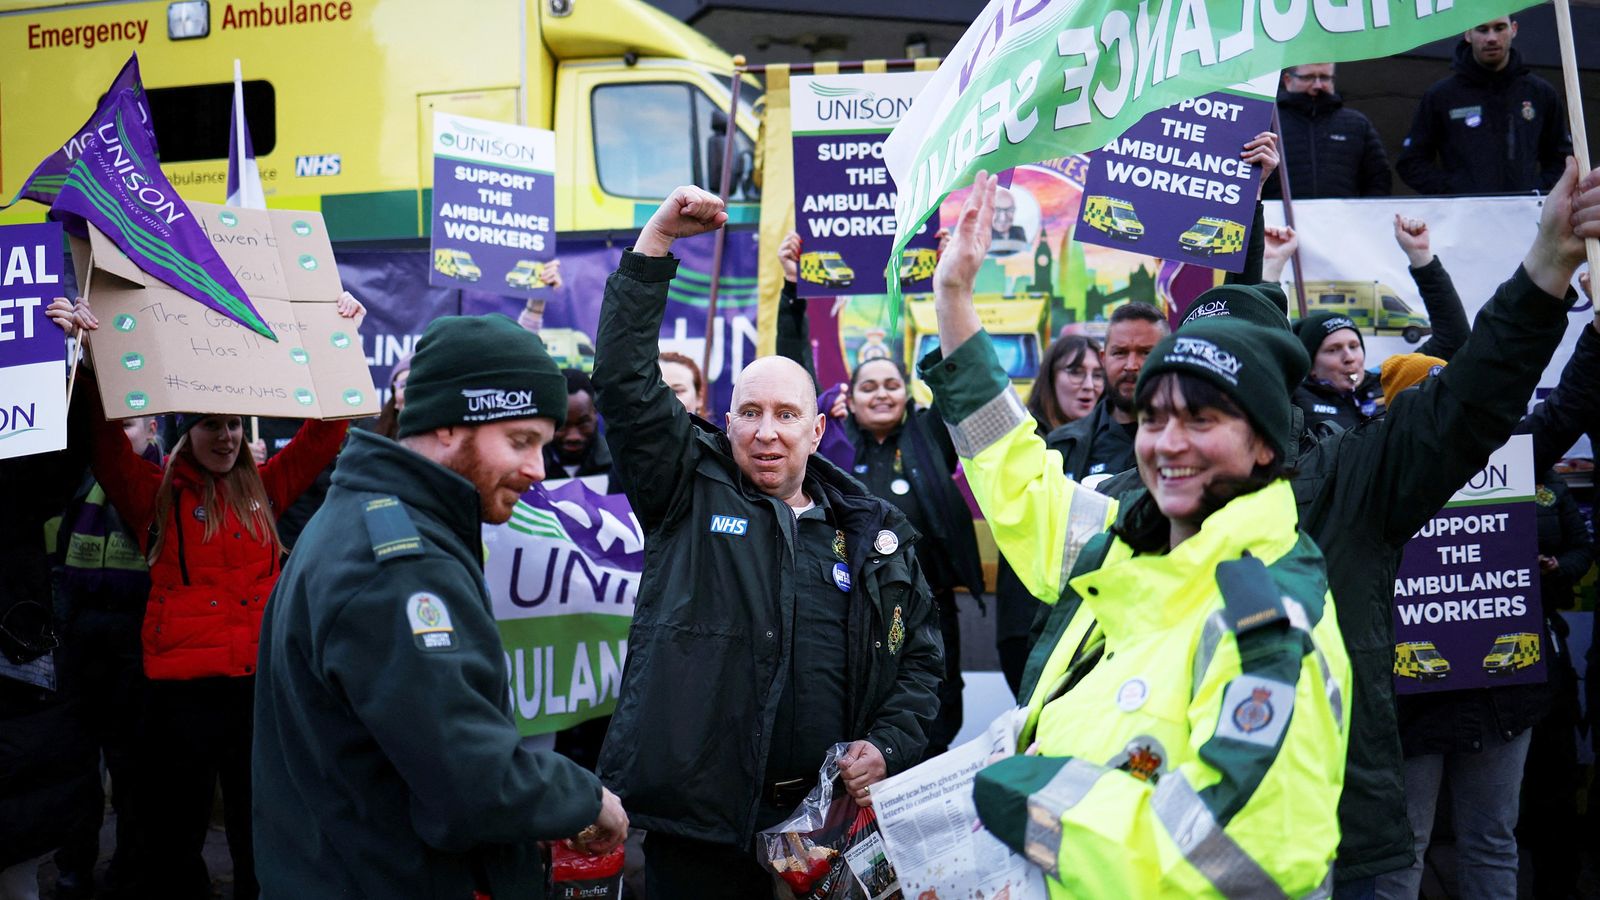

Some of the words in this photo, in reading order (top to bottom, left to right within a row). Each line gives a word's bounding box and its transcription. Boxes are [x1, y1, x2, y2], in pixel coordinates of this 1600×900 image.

[28, 20, 148, 50] Emergency
[222, 0, 353, 31] Ambulance
[817, 97, 913, 121] UNISON
[1166, 97, 1244, 122] PORT
[1161, 117, 1208, 143] THE
[455, 134, 535, 161] UNISON
[817, 141, 886, 161] SUPPO
[1103, 137, 1253, 181] AMBULANCE
[98, 122, 185, 224] UNISON
[296, 156, 341, 177] NHS
[454, 165, 536, 192] SUPPORT
[846, 167, 888, 186] THE
[1105, 160, 1242, 205] WORKERS
[477, 187, 513, 207] THE
[802, 192, 900, 213] AMBULAN
[439, 202, 550, 233] AMBULANCE
[808, 215, 927, 238] WORKE
[443, 220, 546, 252] WORKERS
[0, 244, 59, 287] AL
[139, 302, 190, 326] The
[1173, 339, 1243, 374] UNISON
[467, 388, 533, 412] UNISON
[711, 516, 748, 536] NHS
[1437, 544, 1481, 565] THE
[509, 546, 637, 609] UNI
[1394, 569, 1531, 598] AMBULANCE
[1397, 595, 1527, 625] WORKERS
[880, 793, 906, 810] Female
[938, 772, 958, 788] given
[882, 806, 905, 820] letters
[914, 790, 942, 807] combat
